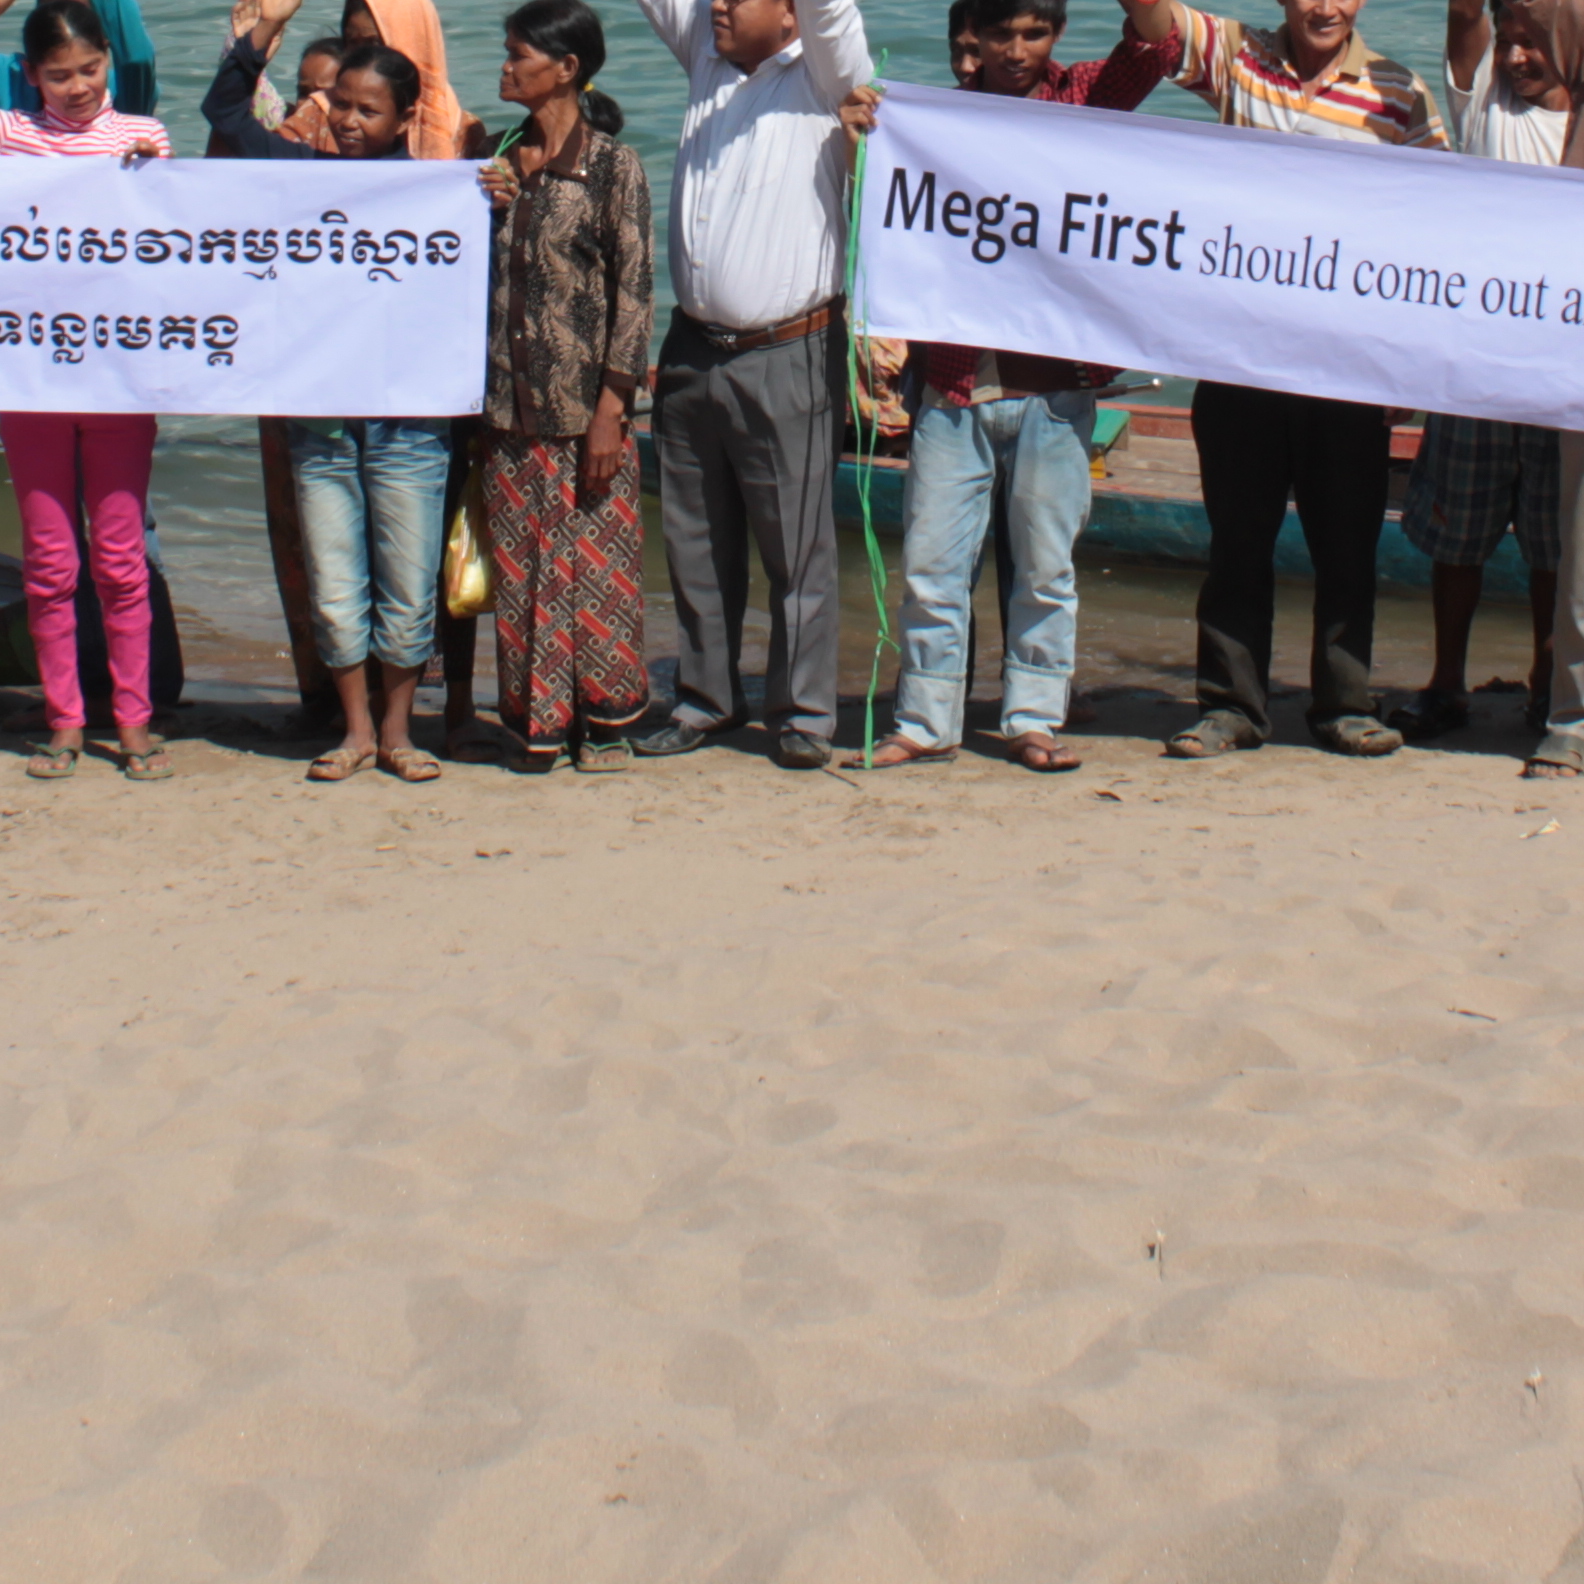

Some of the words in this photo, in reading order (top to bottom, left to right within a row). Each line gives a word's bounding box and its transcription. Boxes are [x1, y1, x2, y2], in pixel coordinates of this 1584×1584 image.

[883, 168, 1039, 264] Mega
[1059, 192, 1185, 271] First
[1200, 225, 1339, 291] should
[1353, 260, 1466, 309] come
[1481, 277, 1549, 320] out
